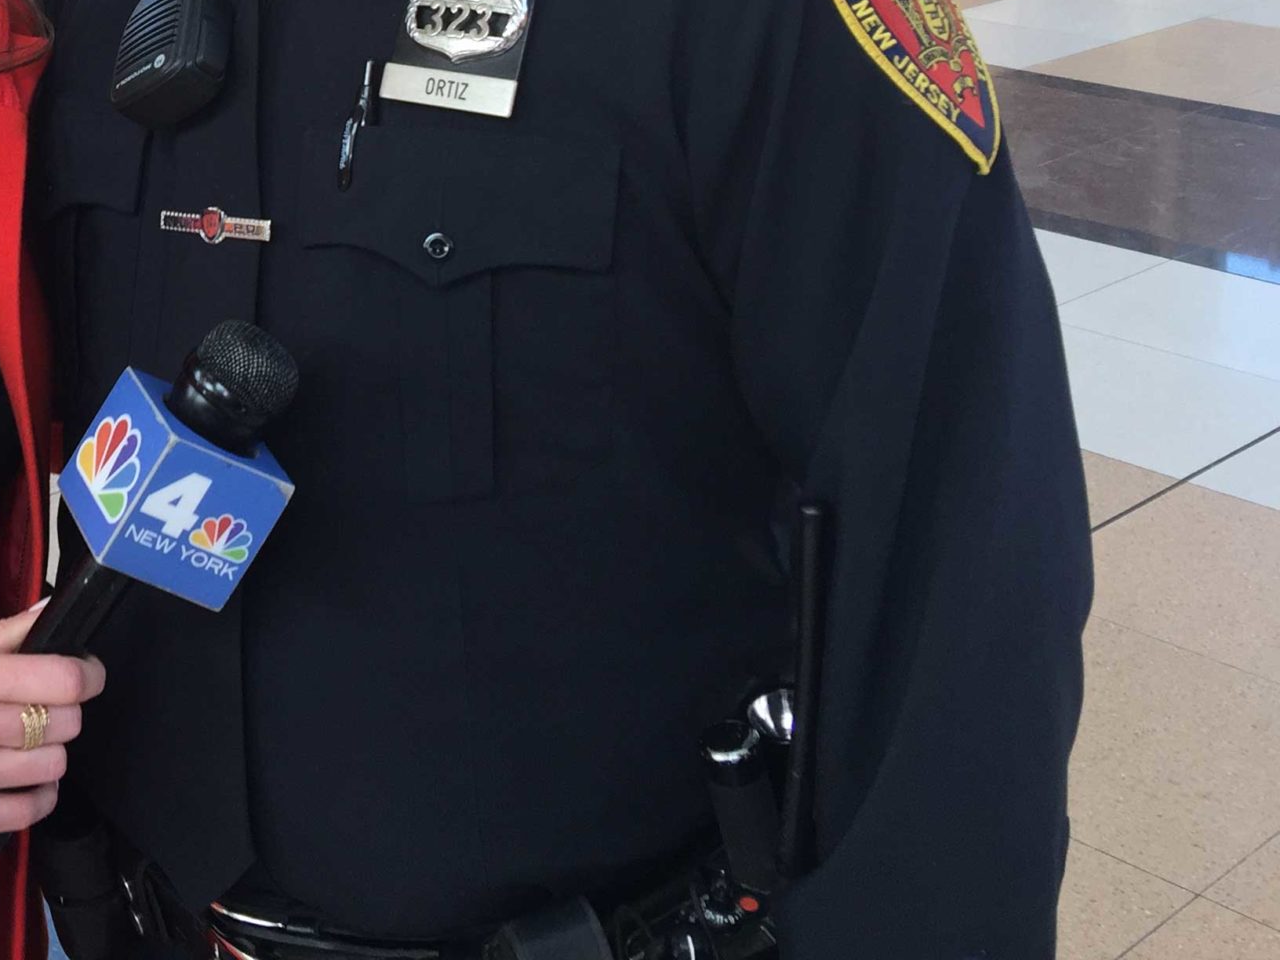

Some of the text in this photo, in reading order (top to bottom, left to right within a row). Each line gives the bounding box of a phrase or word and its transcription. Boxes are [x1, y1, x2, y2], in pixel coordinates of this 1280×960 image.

[424, 0, 492, 40] 323
[425, 77, 469, 101] ORTIZ
[893, 54, 960, 123] JERSEY
[139, 472, 213, 539] 4
[125, 523, 239, 581] NEW YORK
